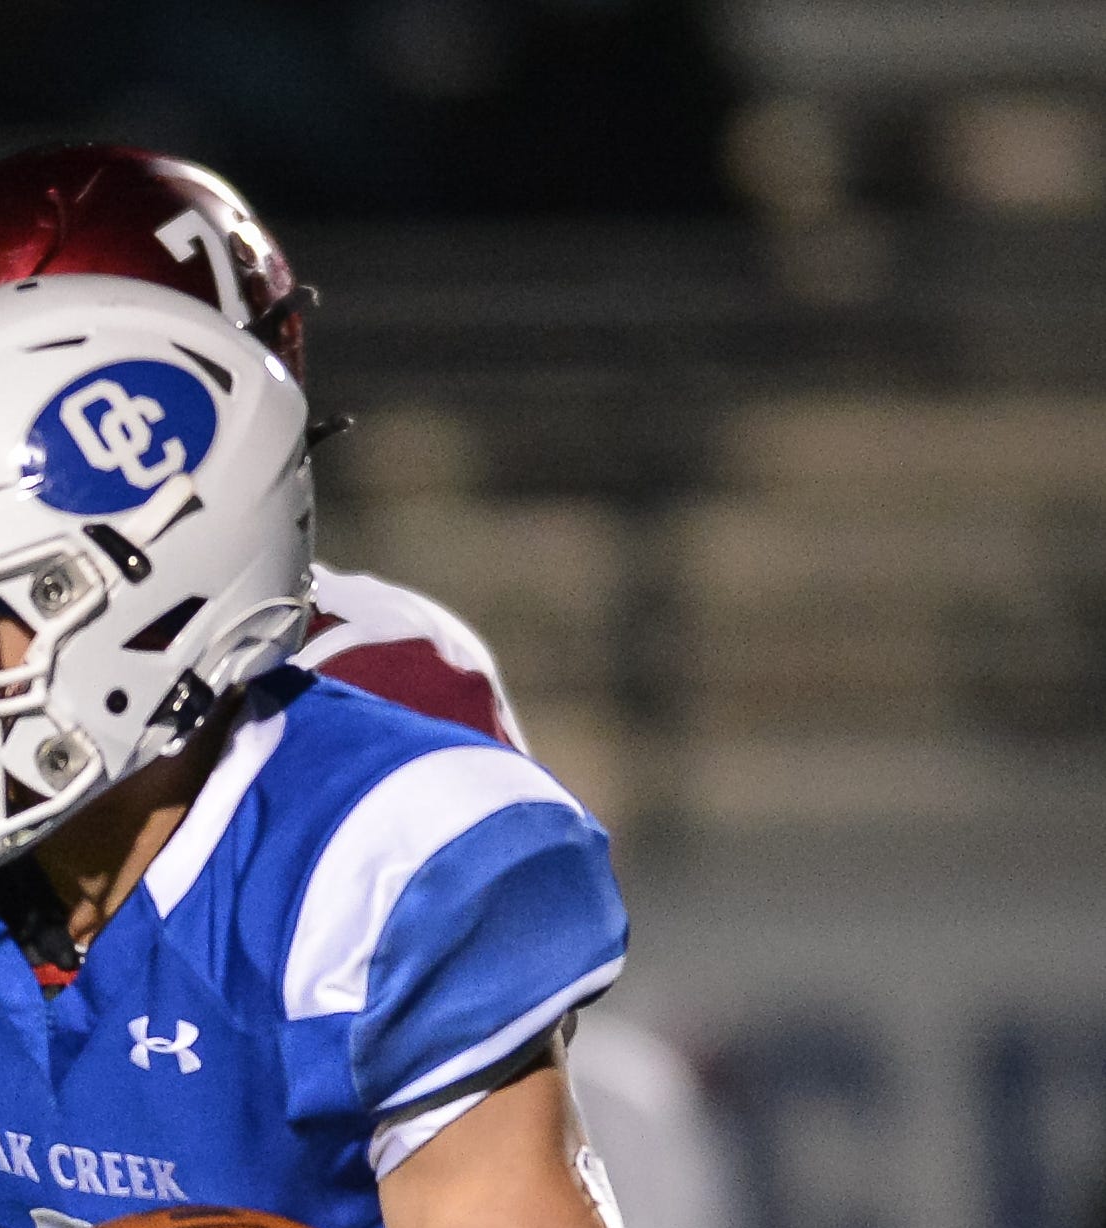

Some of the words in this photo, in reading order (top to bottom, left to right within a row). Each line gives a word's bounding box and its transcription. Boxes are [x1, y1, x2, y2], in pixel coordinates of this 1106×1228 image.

[154, 209, 250, 328] 7
[59, 379, 187, 489] OC
[48, 1143, 190, 1201] CREEK
